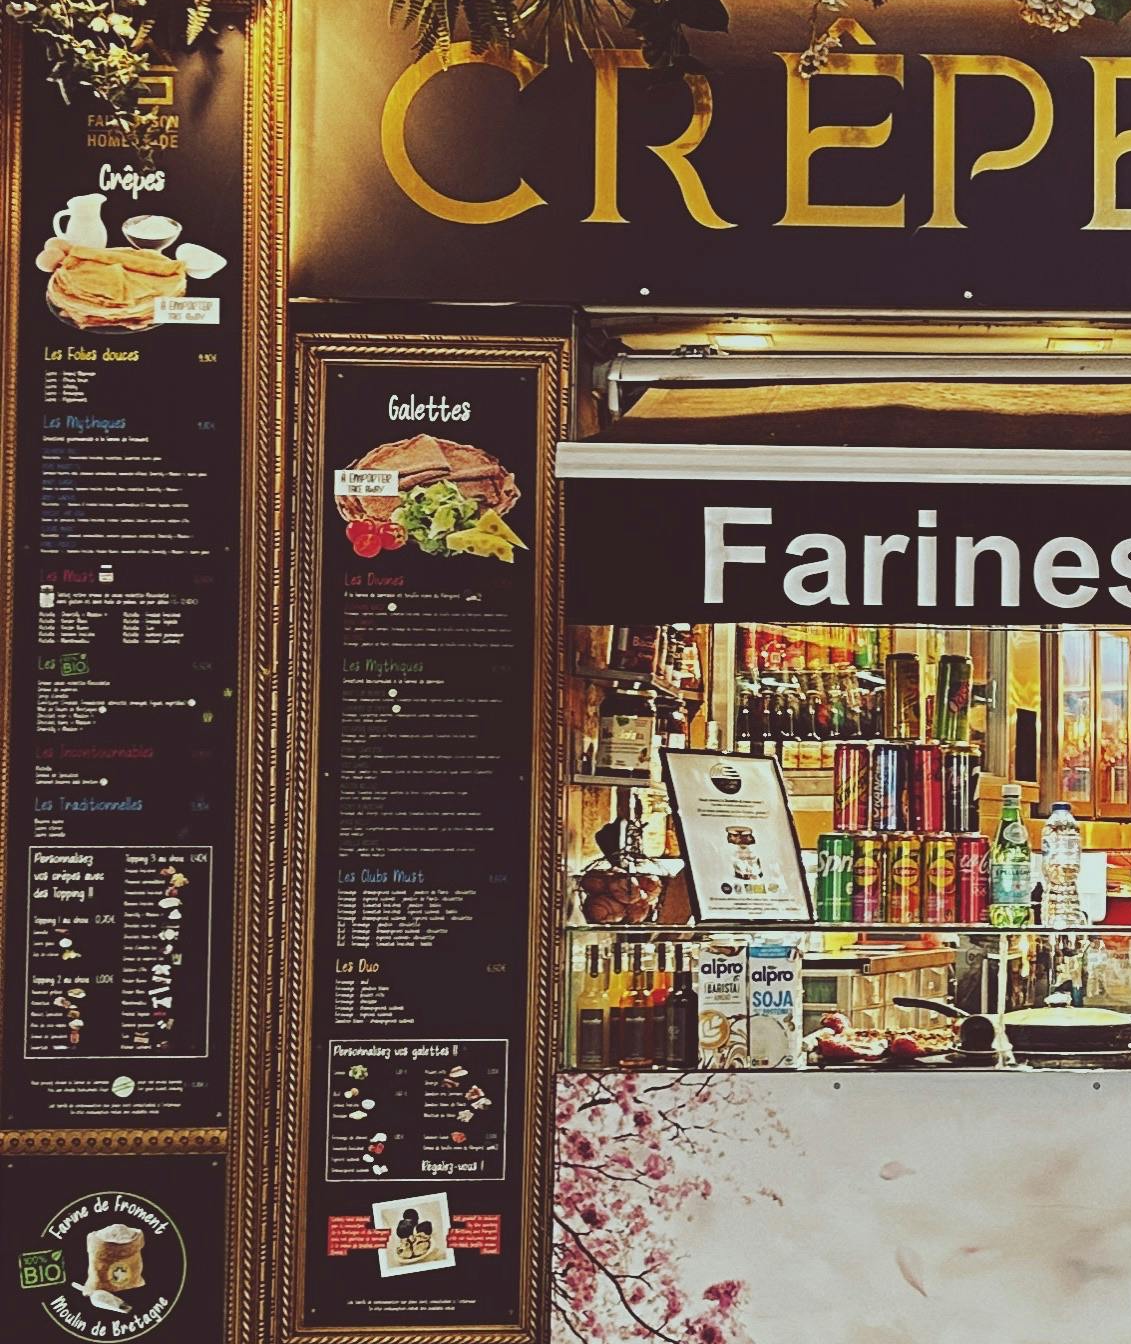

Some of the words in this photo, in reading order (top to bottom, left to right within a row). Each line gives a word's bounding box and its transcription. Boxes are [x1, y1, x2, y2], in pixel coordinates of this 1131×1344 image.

[99, 163, 166, 200] Crêpes
[44, 346, 62, 361] Les
[102, 346, 140, 362] douces
[388, 393, 472, 423] Galettes
[33, 851, 94, 867] Personnalisez
[51, 869, 81, 884] crêpes
[338, 869, 356, 883] Les
[393, 869, 425, 884] Must
[33, 887, 49, 899] des
[52, 886, 85, 903] Topping
[335, 958, 354, 973] Les
[358, 958, 379, 973] Duo
[701, 958, 744, 978] alpro
[751, 965, 794, 986] alpro
[707, 982, 738, 994] BARISTA
[752, 990, 794, 1007] SOJA
[333, 1044, 391, 1060] Personnalisez
[394, 1046, 409, 1057] vos
[411, 1044, 450, 1061] galettes
[48, 1206, 89, 1240] Farine
[93, 1196, 110, 1213] de
[23, 1263, 62, 1285] BIO
[50, 1294, 87, 1332] Moulin
[91, 1320, 107, 1337] de
[112, 1295, 169, 1337] Bretagne
